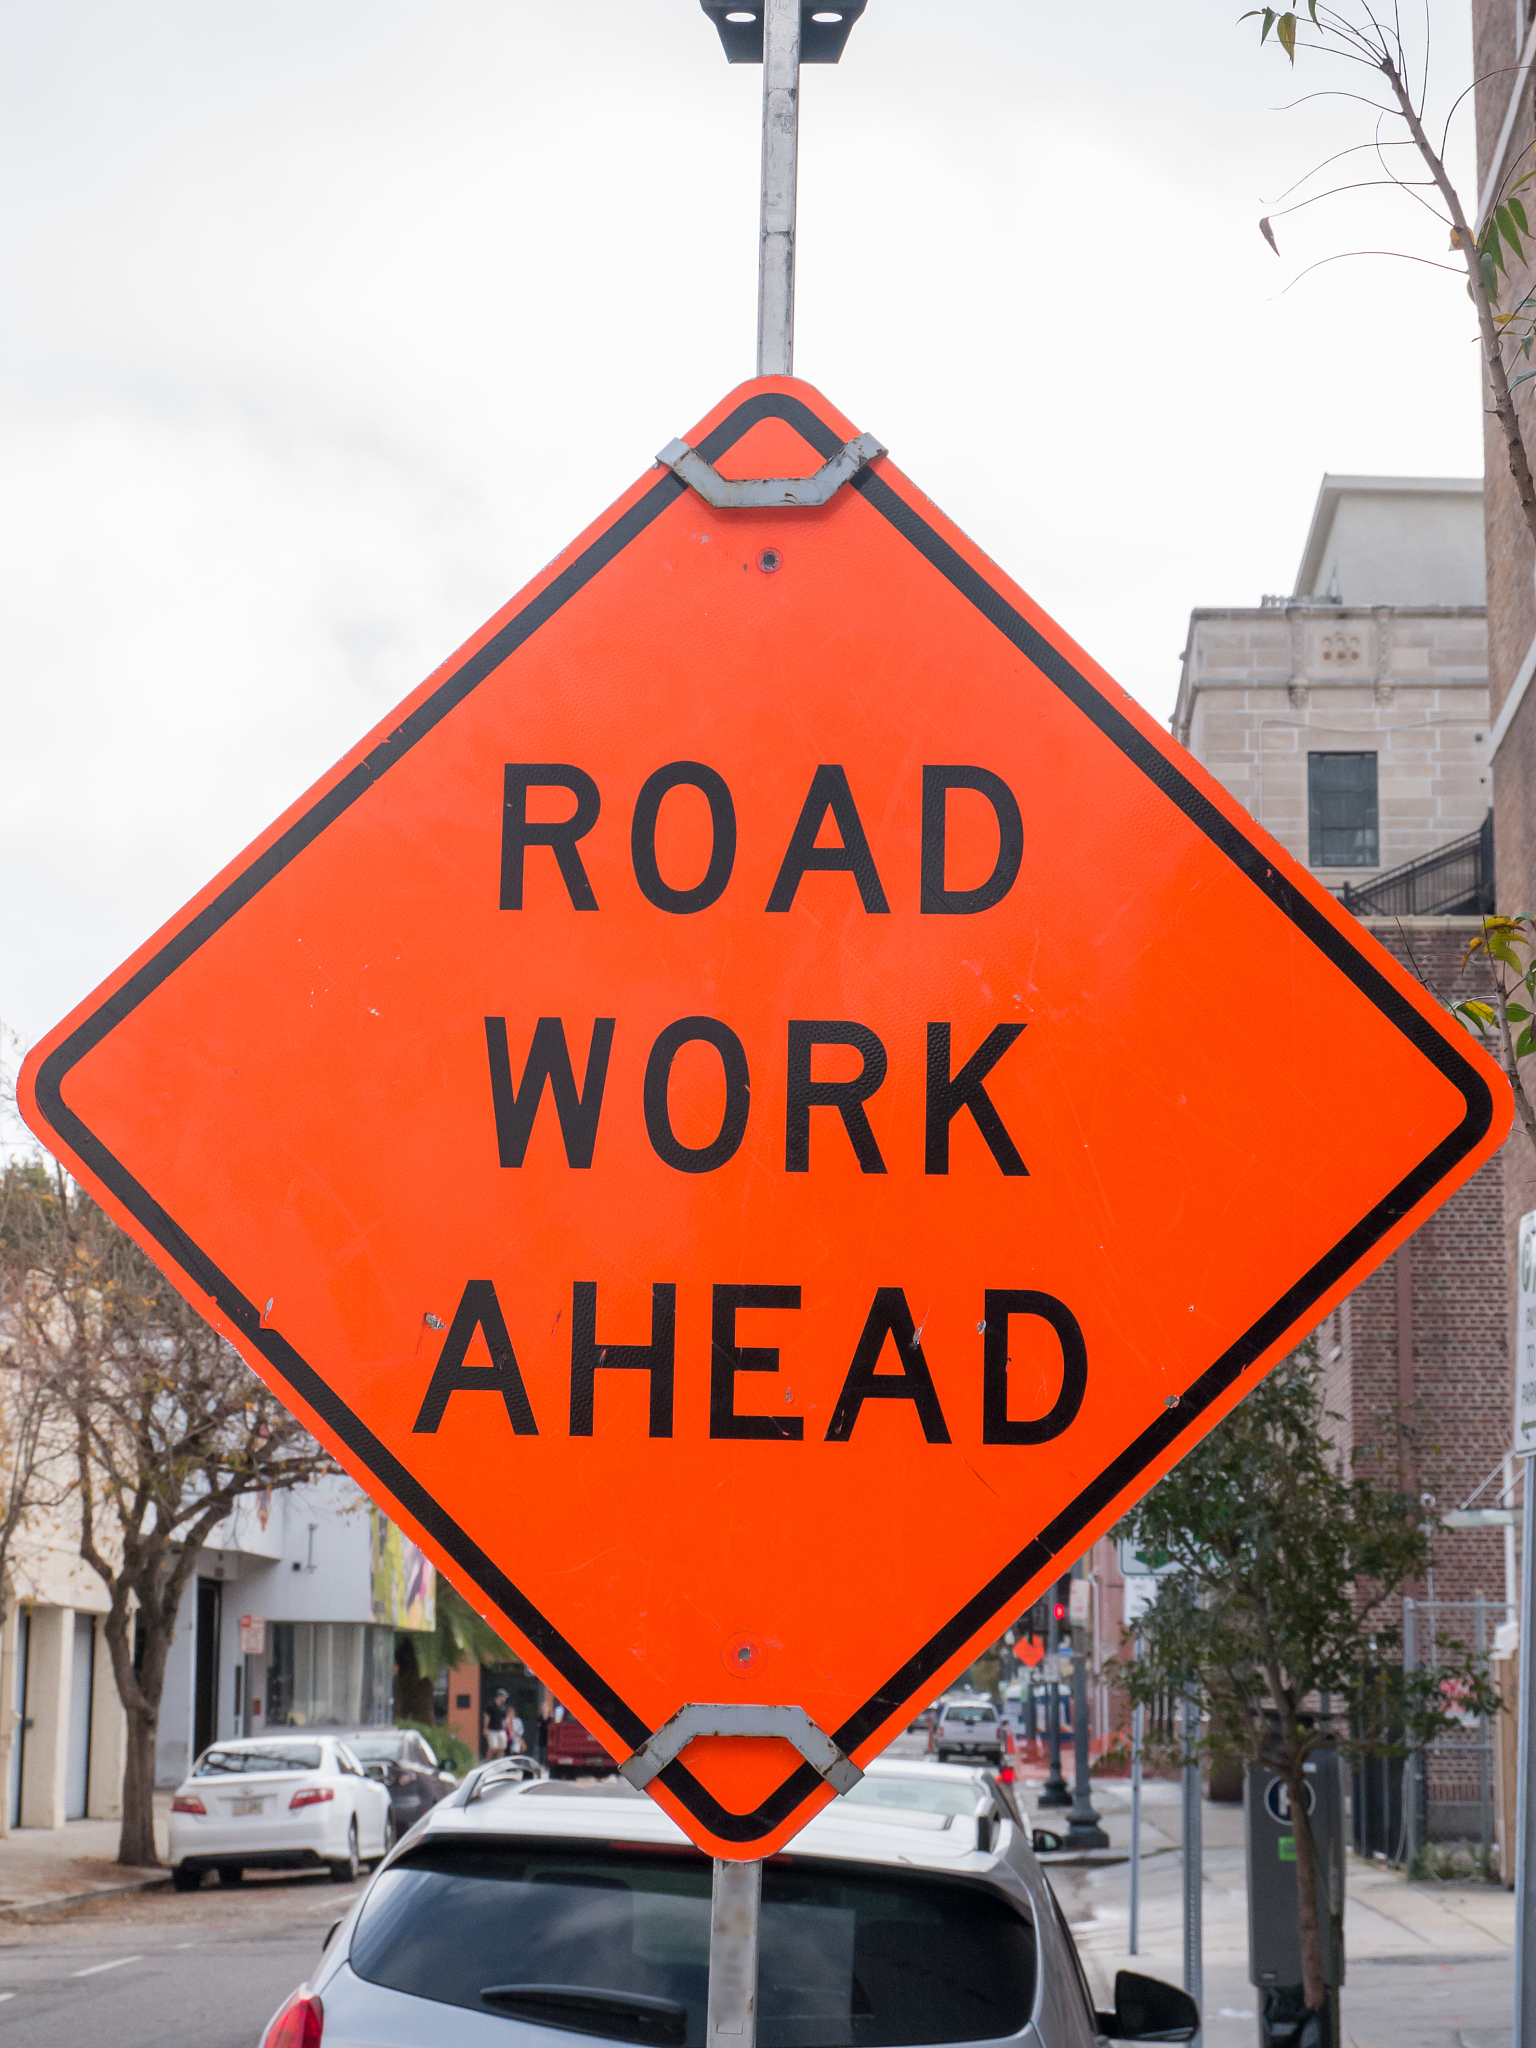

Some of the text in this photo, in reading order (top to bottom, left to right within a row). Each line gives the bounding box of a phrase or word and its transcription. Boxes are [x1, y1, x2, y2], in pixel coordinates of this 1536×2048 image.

[500, 760, 1024, 914] ROAD
[484, 1016, 1031, 1177] WORK
[412, 1279, 1088, 1446] AHEAD
